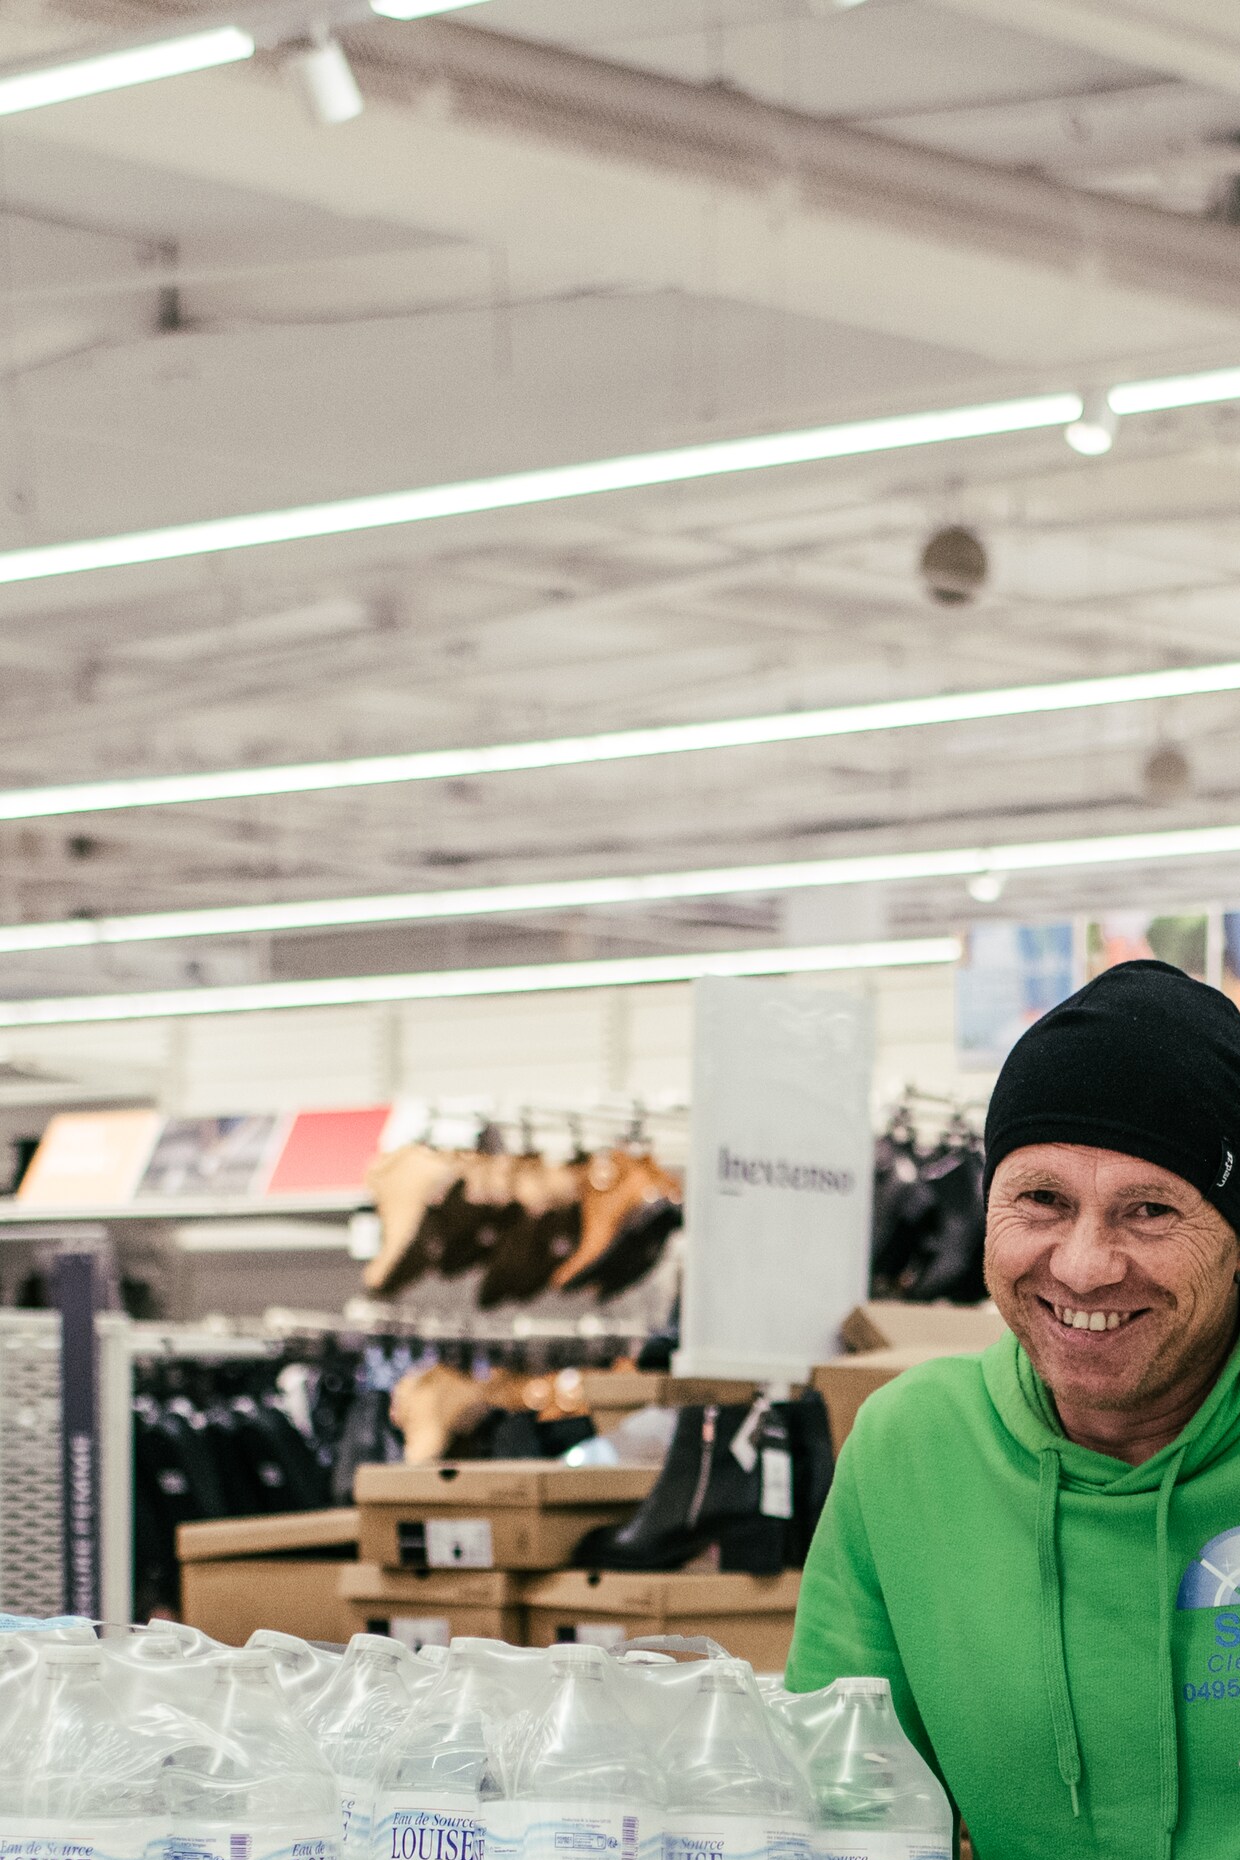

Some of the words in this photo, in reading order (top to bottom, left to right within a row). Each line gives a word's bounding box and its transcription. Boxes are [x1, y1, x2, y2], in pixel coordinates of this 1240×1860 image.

[393, 1812, 412, 1826] Eau
[415, 1812, 430, 1826] de
[26, 1840, 42, 1856] de
[292, 1843, 312, 1857] Eau
[314, 1840, 326, 1854] de
